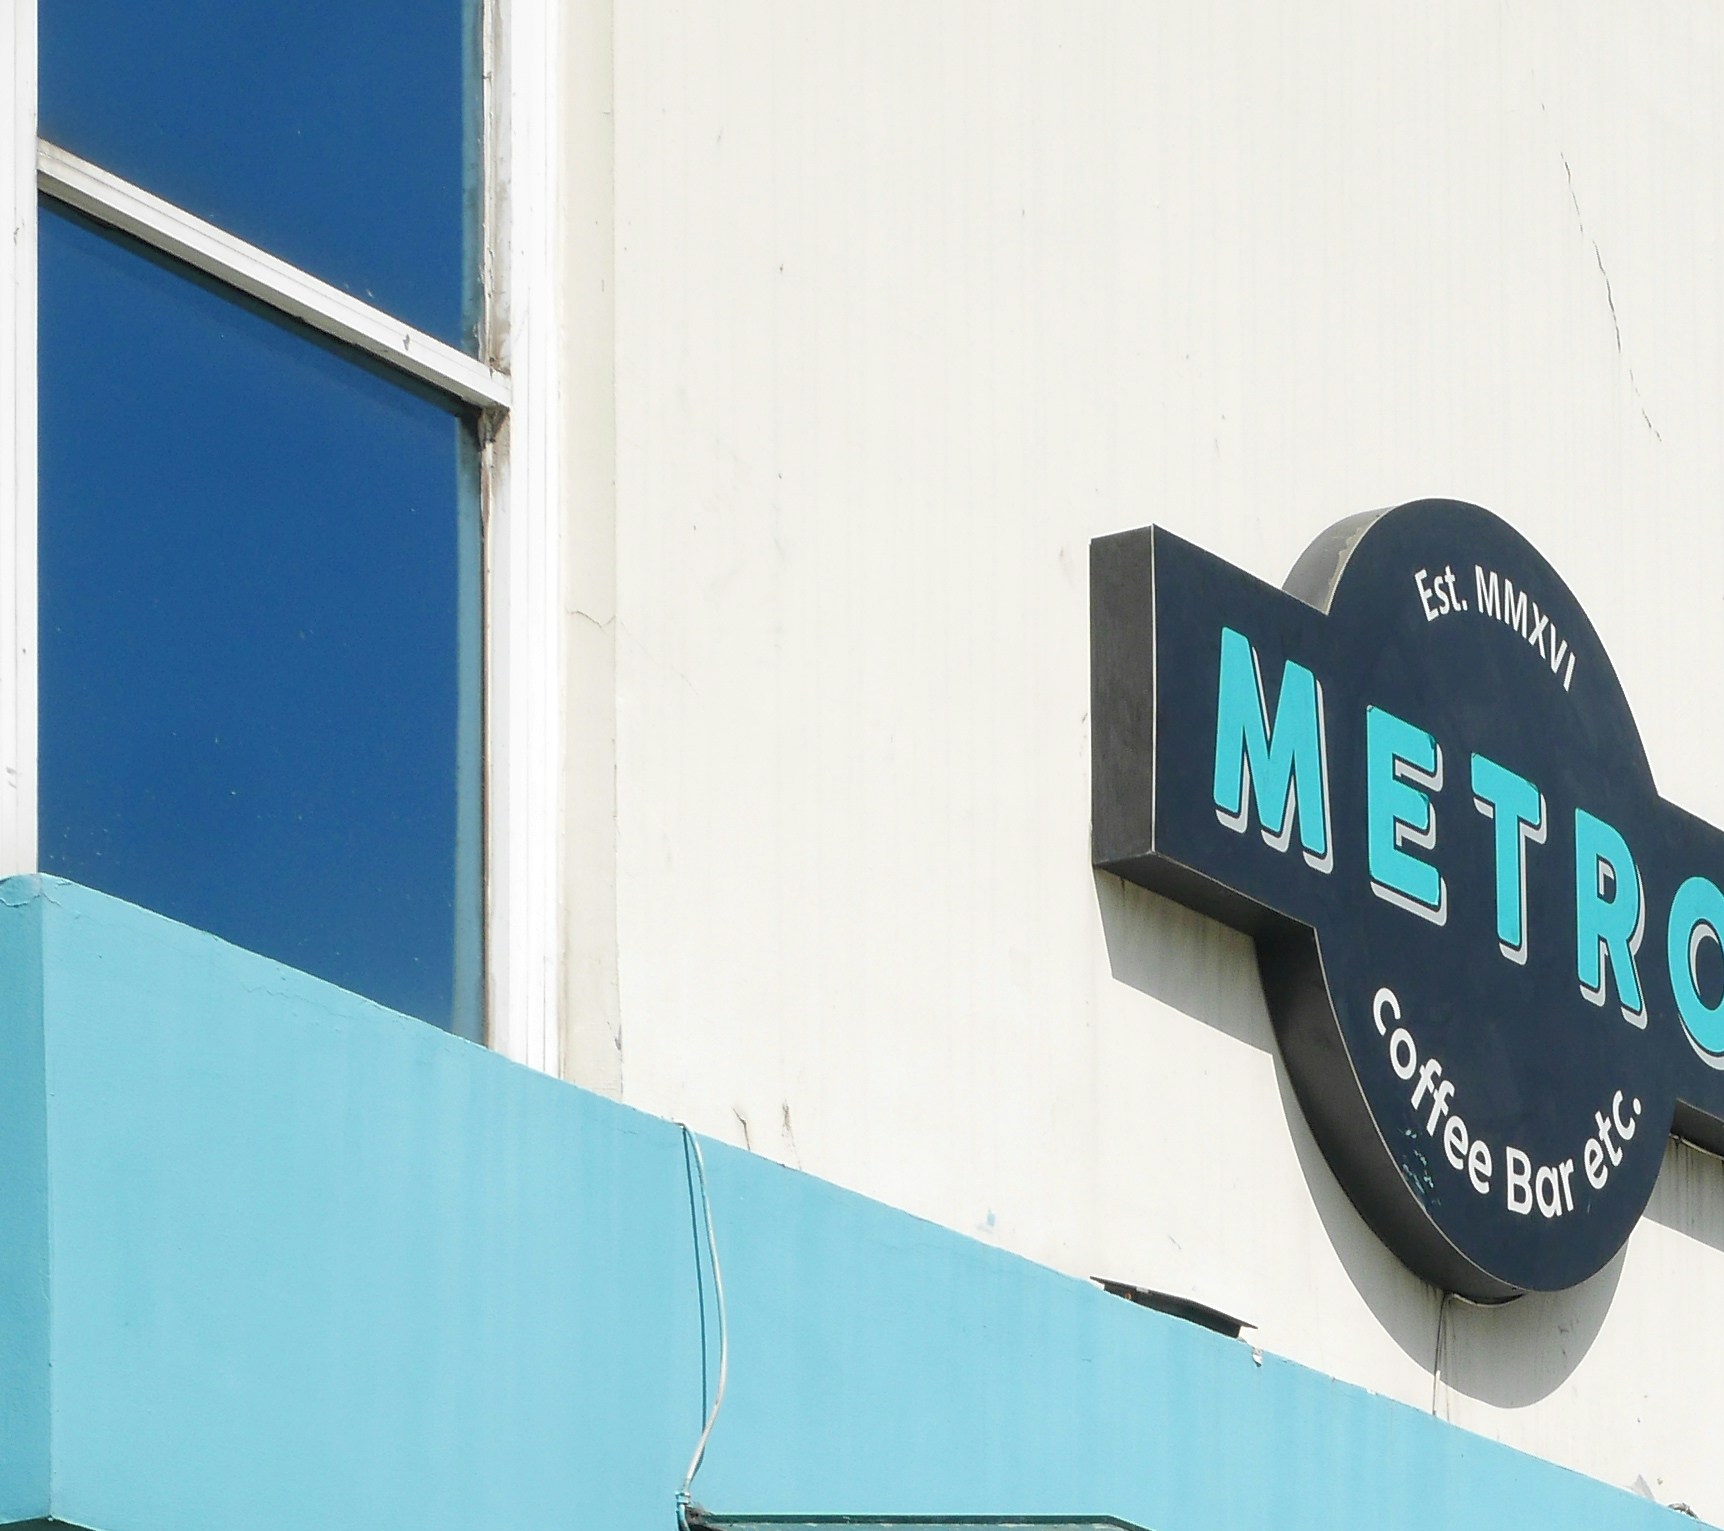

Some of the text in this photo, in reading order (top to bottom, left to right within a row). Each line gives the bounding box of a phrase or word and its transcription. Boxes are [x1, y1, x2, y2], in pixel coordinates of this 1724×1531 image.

[1414, 564, 1577, 692] Est. MMXVI
[1507, 1147, 1576, 1218] Bar
[1584, 1088, 1643, 1191] etc.
